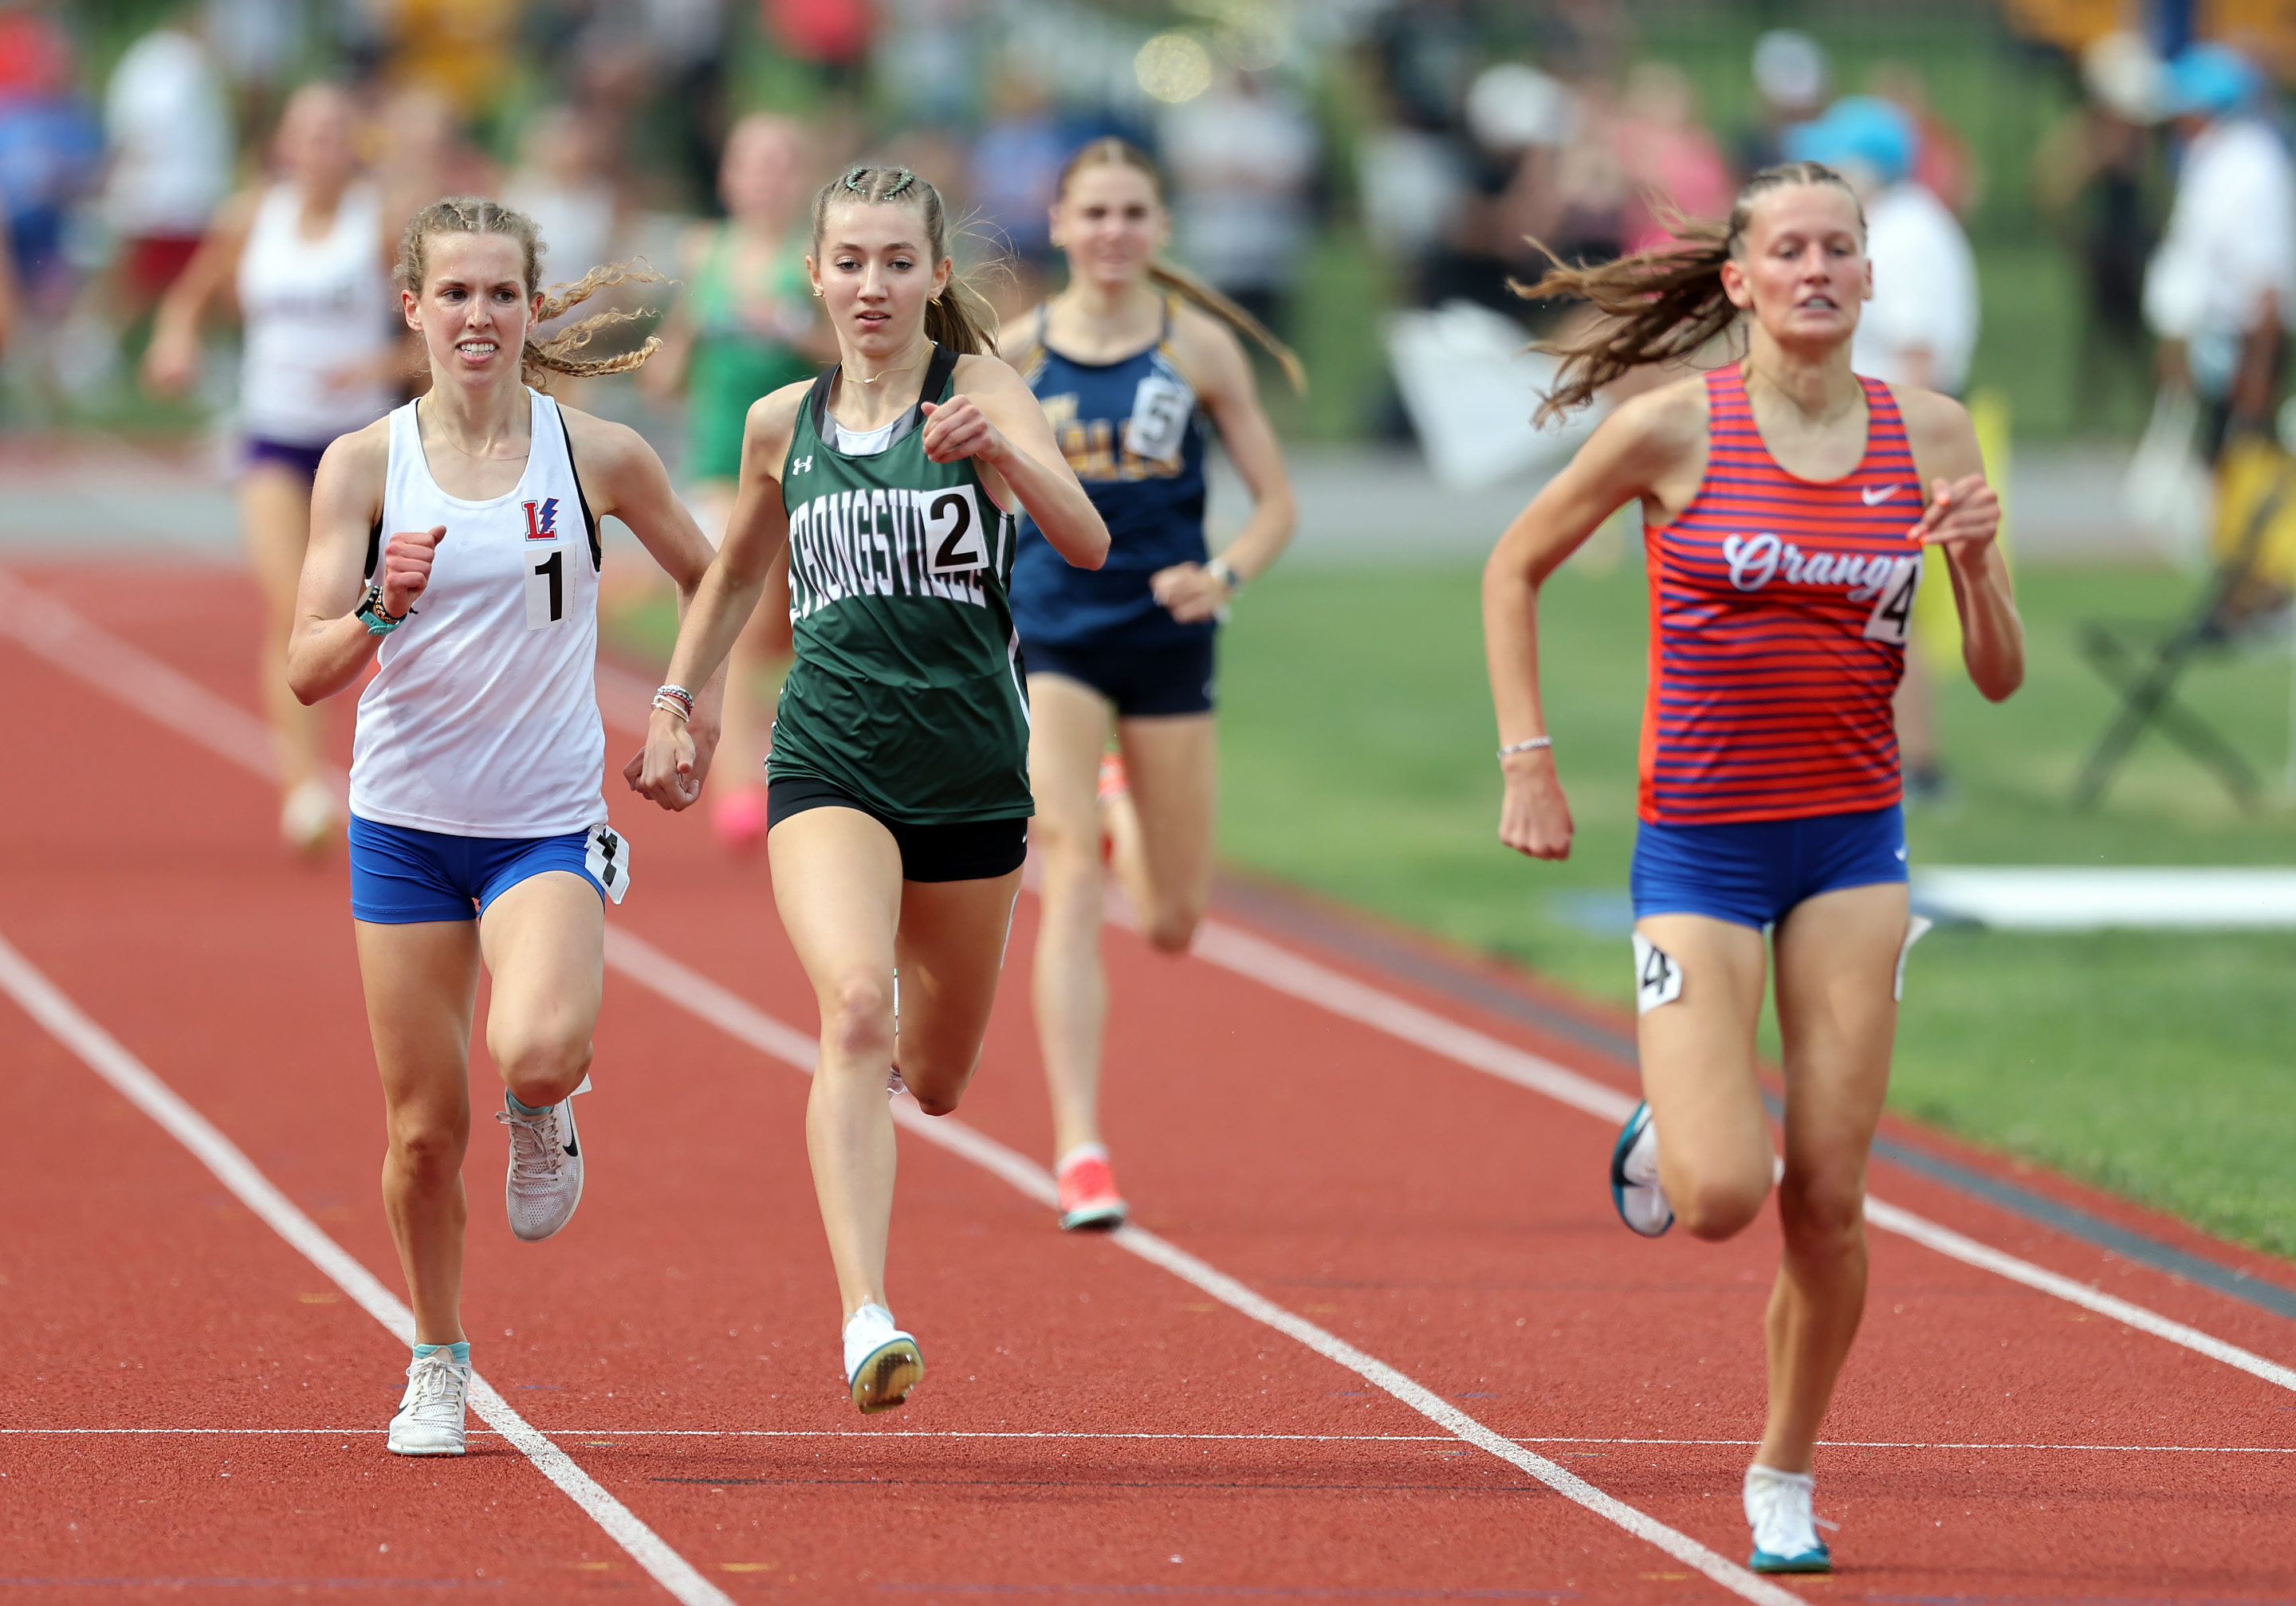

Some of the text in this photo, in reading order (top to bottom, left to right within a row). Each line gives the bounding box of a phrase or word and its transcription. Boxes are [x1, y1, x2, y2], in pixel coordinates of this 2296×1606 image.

[1142, 393, 1177, 447] 5
[930, 493, 979, 567] 2
[535, 551, 562, 622] 1
[1722, 532, 1909, 603] Orang
[1881, 563, 1917, 637] 4
[1643, 945, 1672, 995] 4
